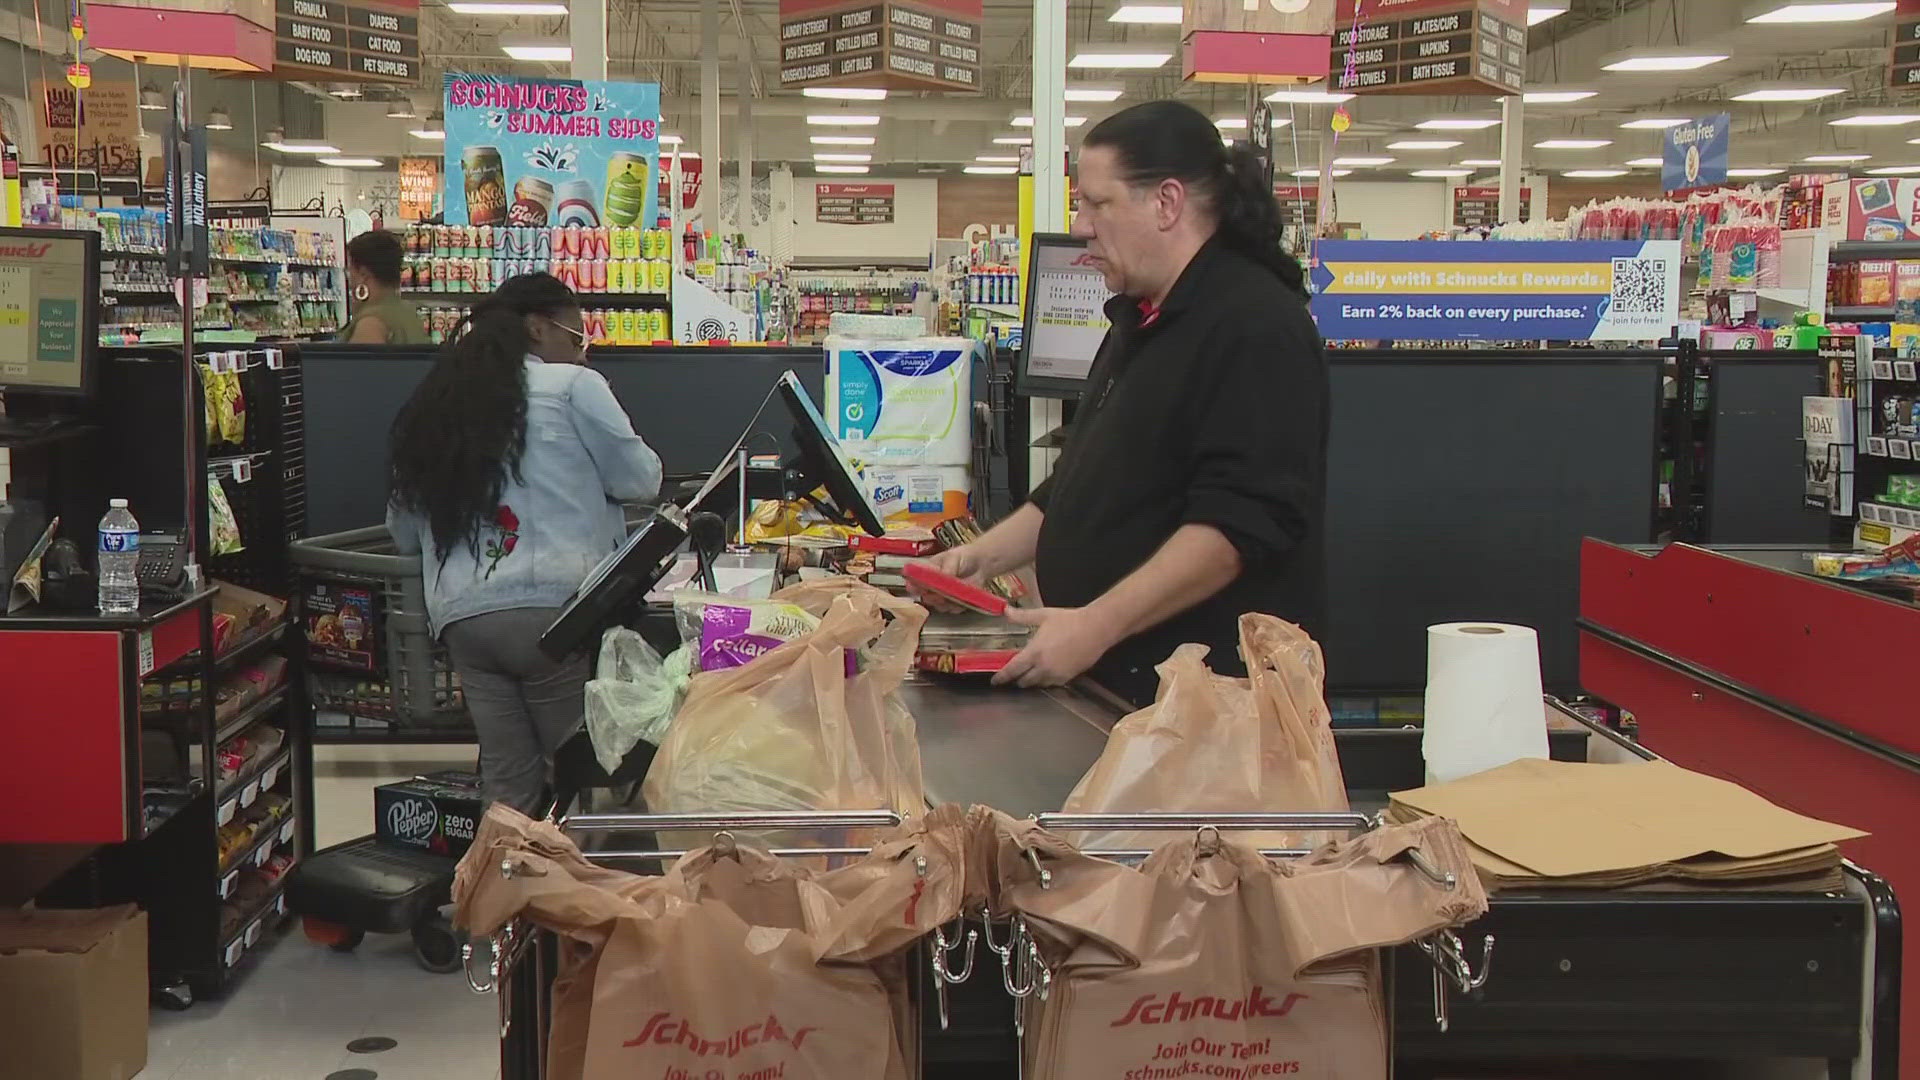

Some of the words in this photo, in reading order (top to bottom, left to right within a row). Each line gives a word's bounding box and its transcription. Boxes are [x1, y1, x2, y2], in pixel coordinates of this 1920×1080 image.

[293, 0, 328, 19] FORMULA
[369, 14, 398, 31] DIAPERS
[841, 10, 873, 28] STATIONERY
[891, 8, 910, 27] LAUNDRY
[910, 12, 933, 31] DETERGENT
[1413, 15, 1459, 35] PLATES/CUPS
[292, 23, 311, 40] BABY
[312, 27, 331, 43] FOOD
[783, 23, 802, 39] LAUNDRY
[803, 18, 828, 35] DETERGENT
[945, 22, 972, 39] STATIONERY
[1358, 26, 1389, 43] STORAGE
[368, 36, 382, 50] CAT
[383, 38, 401, 53] FOOD
[836, 35, 860, 52] DISTILLED
[861, 32, 879, 48] WATER
[894, 32, 905, 48] DISH
[905, 35, 931, 53] DETERGENT
[1420, 39, 1450, 57] NAPKINS
[295, 48, 311, 63] DOG
[312, 51, 331, 66] FOOD
[785, 47, 797, 61] DISH
[798, 42, 825, 58] DETERGENT
[940, 43, 962, 60] DISTILLED
[962, 47, 977, 63] WATER
[1365, 48, 1383, 63] BAGS
[363, 58, 377, 72] PET
[377, 60, 408, 77] SUPPLIES
[806, 62, 830, 79] CLEANERS
[841, 58, 856, 73] LIGHT
[856, 56, 873, 71] BULBS
[914, 59, 935, 77] CLEANERS
[1412, 65, 1430, 80] BATH
[1432, 61, 1456, 77] TISSUE
[945, 67, 958, 81] LIGHT
[959, 69, 973, 84] BULBS
[1360, 70, 1387, 86] TOWELS
[451, 80, 588, 112] SCHNUCKS
[507, 113, 601, 137] SUMMER
[608, 118, 657, 139] SIPS
[1673, 127, 1696, 145] Gluten
[1697, 123, 1715, 141] Free
[401, 176, 433, 187] WINE
[820, 185, 830, 193] 13
[193, 171, 206, 227] MOLottery
[401, 191, 432, 202] BEER
[466, 185, 505, 203] MANGO
[1457, 189, 1468, 197] 10
[508, 203, 546, 225] Field
[1343, 271, 1386, 290] daily
[1391, 271, 1431, 287] with
[1436, 271, 1518, 287] Schnucks
[1342, 305, 1375, 318] Earn
[1379, 305, 1403, 319] 2%
[1406, 304, 1442, 318] back
[1445, 308, 1464, 318] on
[1468, 307, 1510, 321] every
[1613, 316, 1628, 326] join
[1630, 316, 1642, 325] for
[1644, 316, 1663, 325] free!
[40, 319, 74, 329] Appreciate
[40, 343, 72, 351] Business!
[843, 382, 869, 390] simply
[1805, 416, 1833, 434] D-DAY
[877, 485, 900, 501] Scott
[405, 799, 422, 818] Dr
[393, 802, 433, 837] Pepper
[445, 814, 474, 831] zero
[445, 829, 474, 840] SUGAR
[1152, 1041, 1188, 1061] Join
[1191, 1036, 1226, 1057] Our
